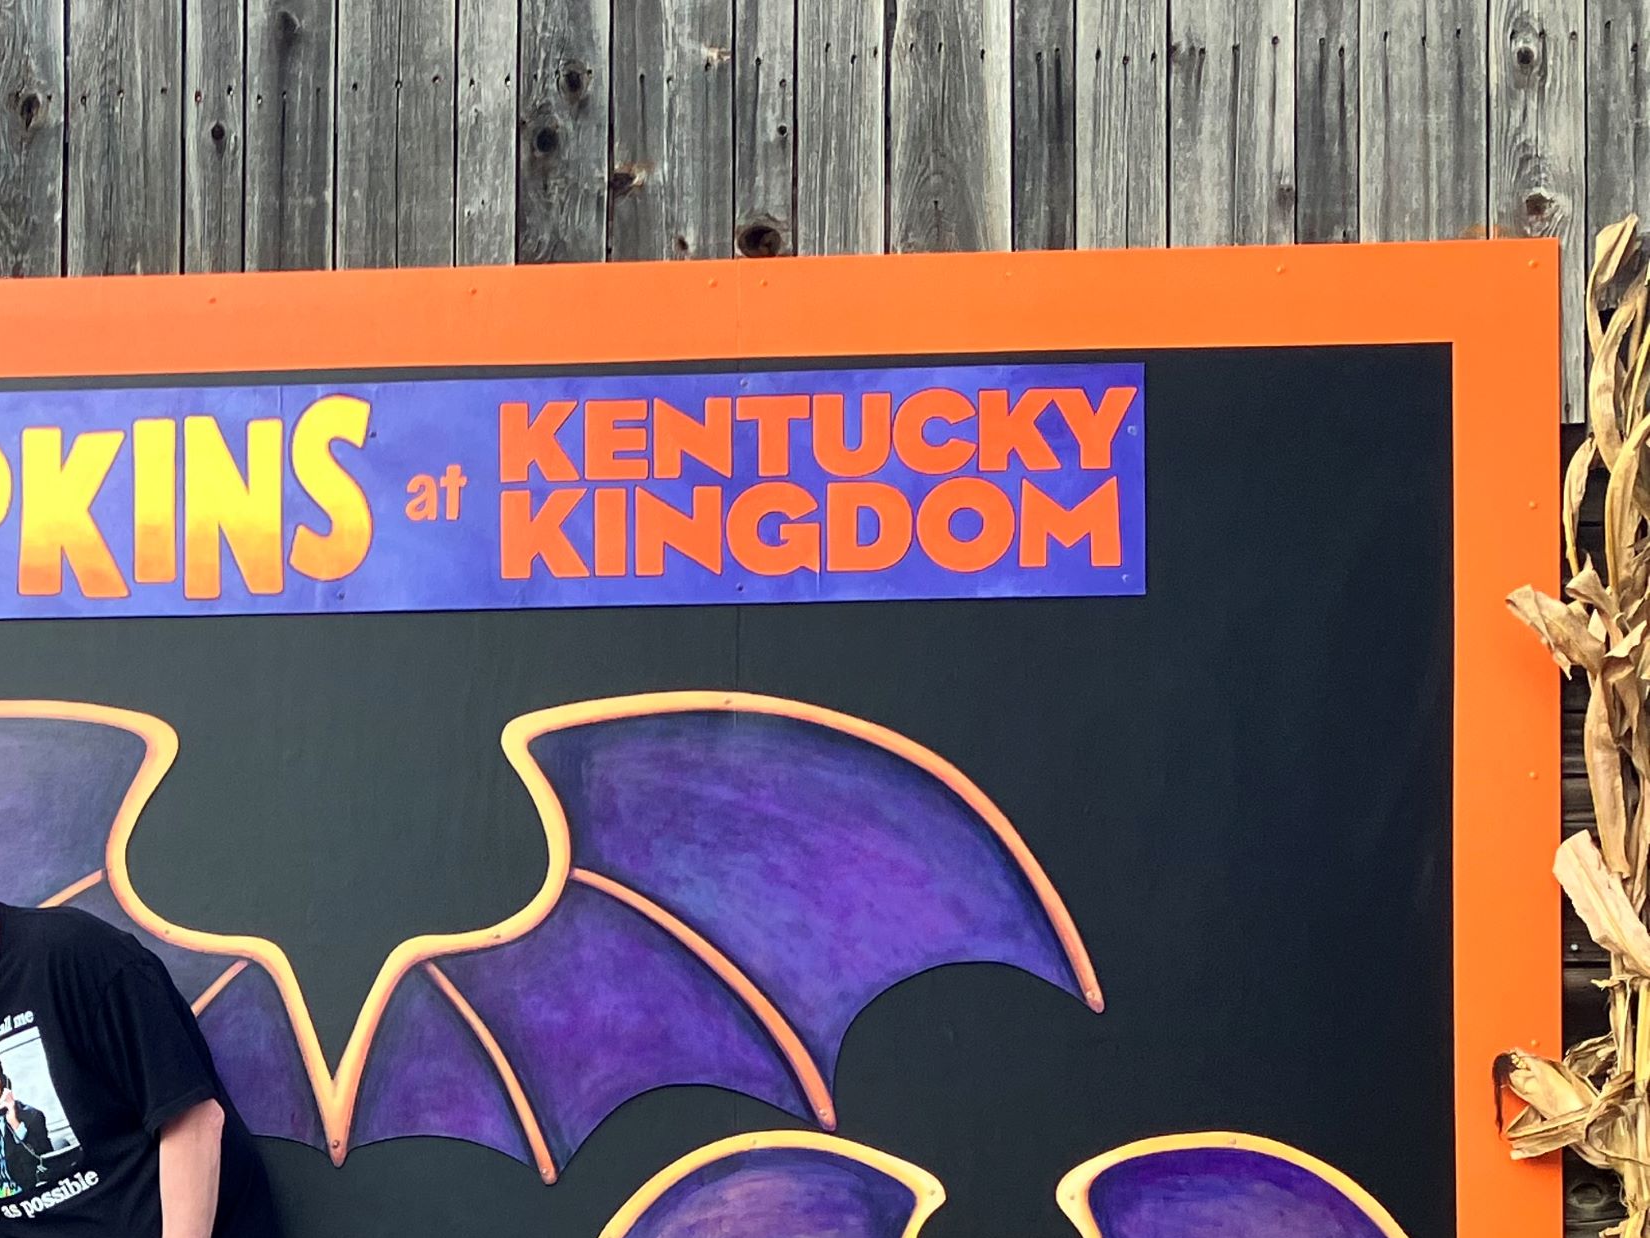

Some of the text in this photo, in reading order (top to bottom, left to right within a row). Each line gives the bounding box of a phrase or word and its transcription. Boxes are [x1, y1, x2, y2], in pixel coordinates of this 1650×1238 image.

[499, 386, 1138, 482] KENTUCKY
[404, 464, 467, 520] at
[499, 475, 1122, 580] KINGDOM
[13, 1010, 34, 1028] me
[0, 1204, 23, 1218] as
[20, 1170, 99, 1218] possible
